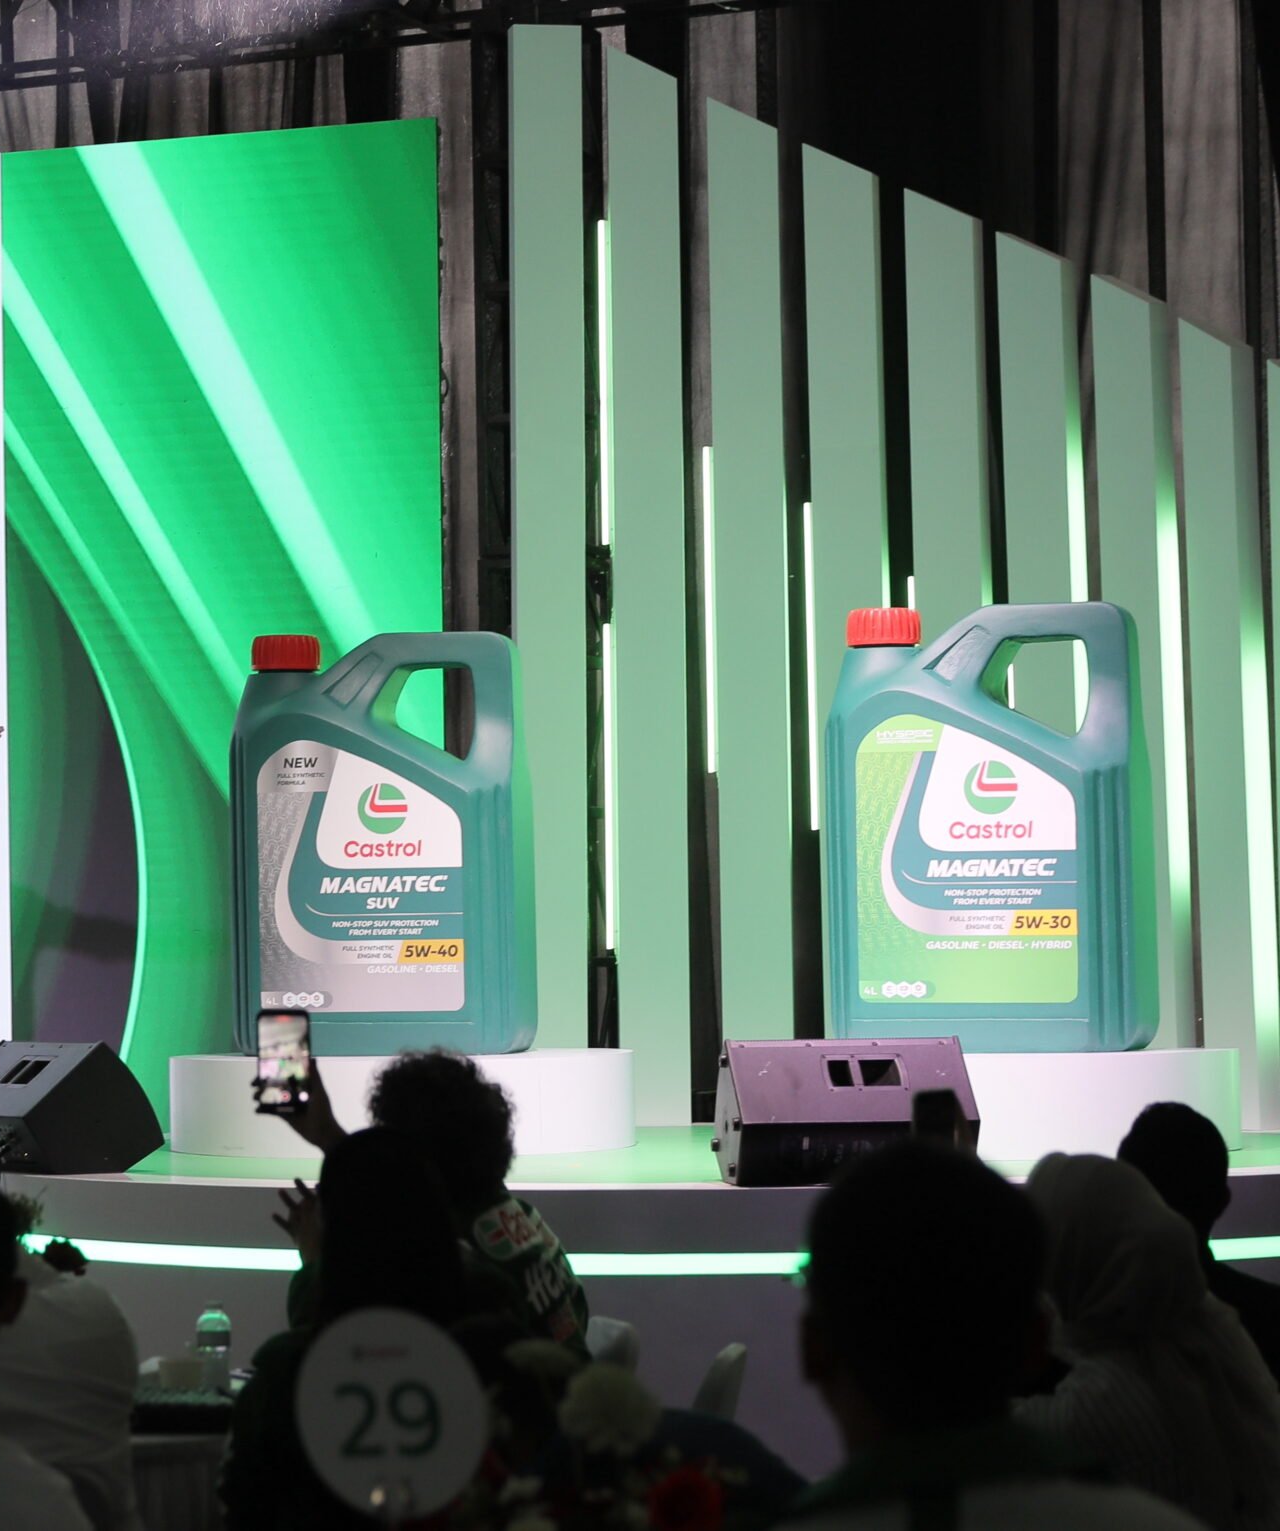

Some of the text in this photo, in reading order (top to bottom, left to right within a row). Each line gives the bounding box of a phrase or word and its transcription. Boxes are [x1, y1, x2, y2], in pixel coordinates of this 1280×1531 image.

[283, 757, 319, 769] NEW
[949, 820, 1033, 839] Castrol
[344, 840, 422, 858] Castrol
[926, 858, 1058, 878] MAGNATEC
[320, 875, 448, 894] MAGNATEC
[944, 888, 1042, 897] NON-STOP PROTECTION
[366, 897, 400, 910] SUV
[979, 897, 1006, 905] EVERY
[332, 919, 439, 928] NON-STOP SUV PROTECTION
[1014, 915, 1072, 929] 5W-30
[348, 928, 373, 936] FROM
[372, 928, 398, 936] EVERY
[926, 940, 1073, 950] GASOLINE DIESEL HYBRID
[404, 945, 459, 958] 5W-40
[367, 964, 459, 974] GASOLINE DIESEL
[864, 986, 878, 996] 4L
[333, 1379, 442, 1459] 29
